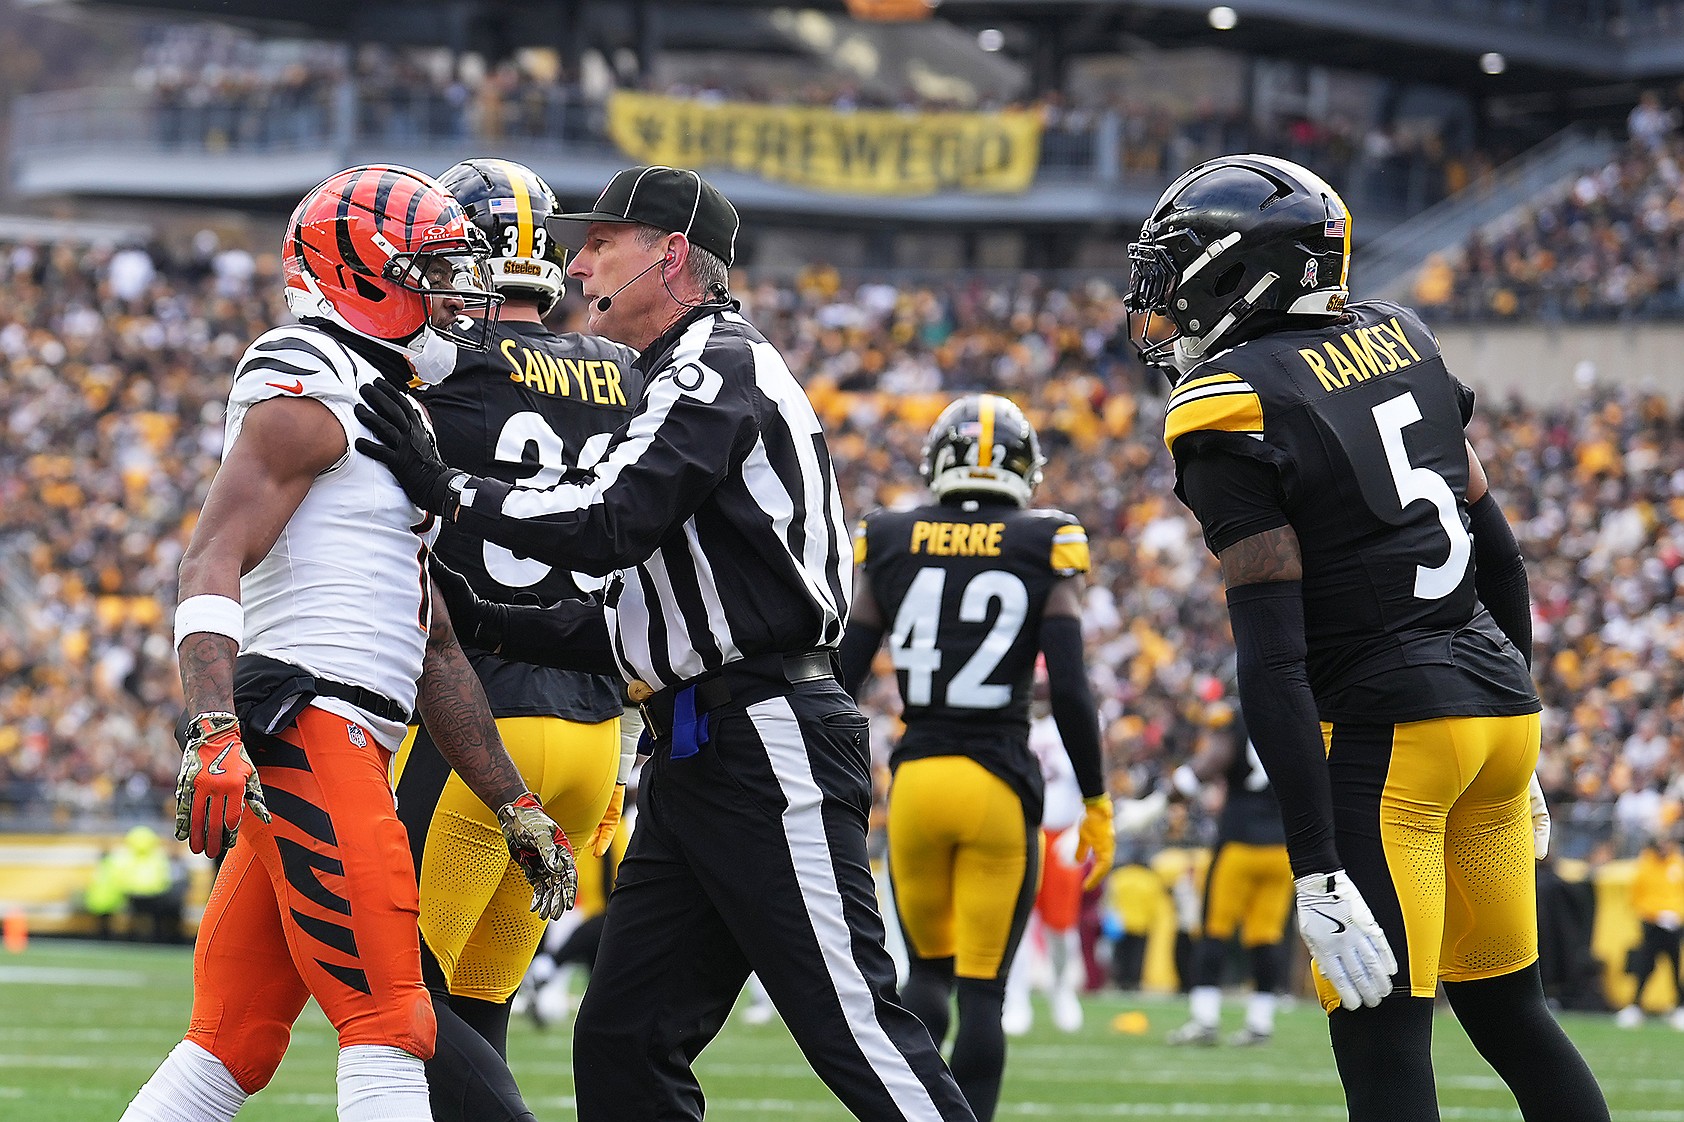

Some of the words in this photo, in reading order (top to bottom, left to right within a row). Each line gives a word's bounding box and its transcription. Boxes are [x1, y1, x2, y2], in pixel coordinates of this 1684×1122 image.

[503, 258, 542, 277] Steelers
[500, 338, 627, 406] SAWYER
[1297, 316, 1421, 393] RAMSEY
[1370, 390, 1471, 600] 5
[910, 521, 1006, 556] PIERRE
[889, 566, 1029, 708] 42
